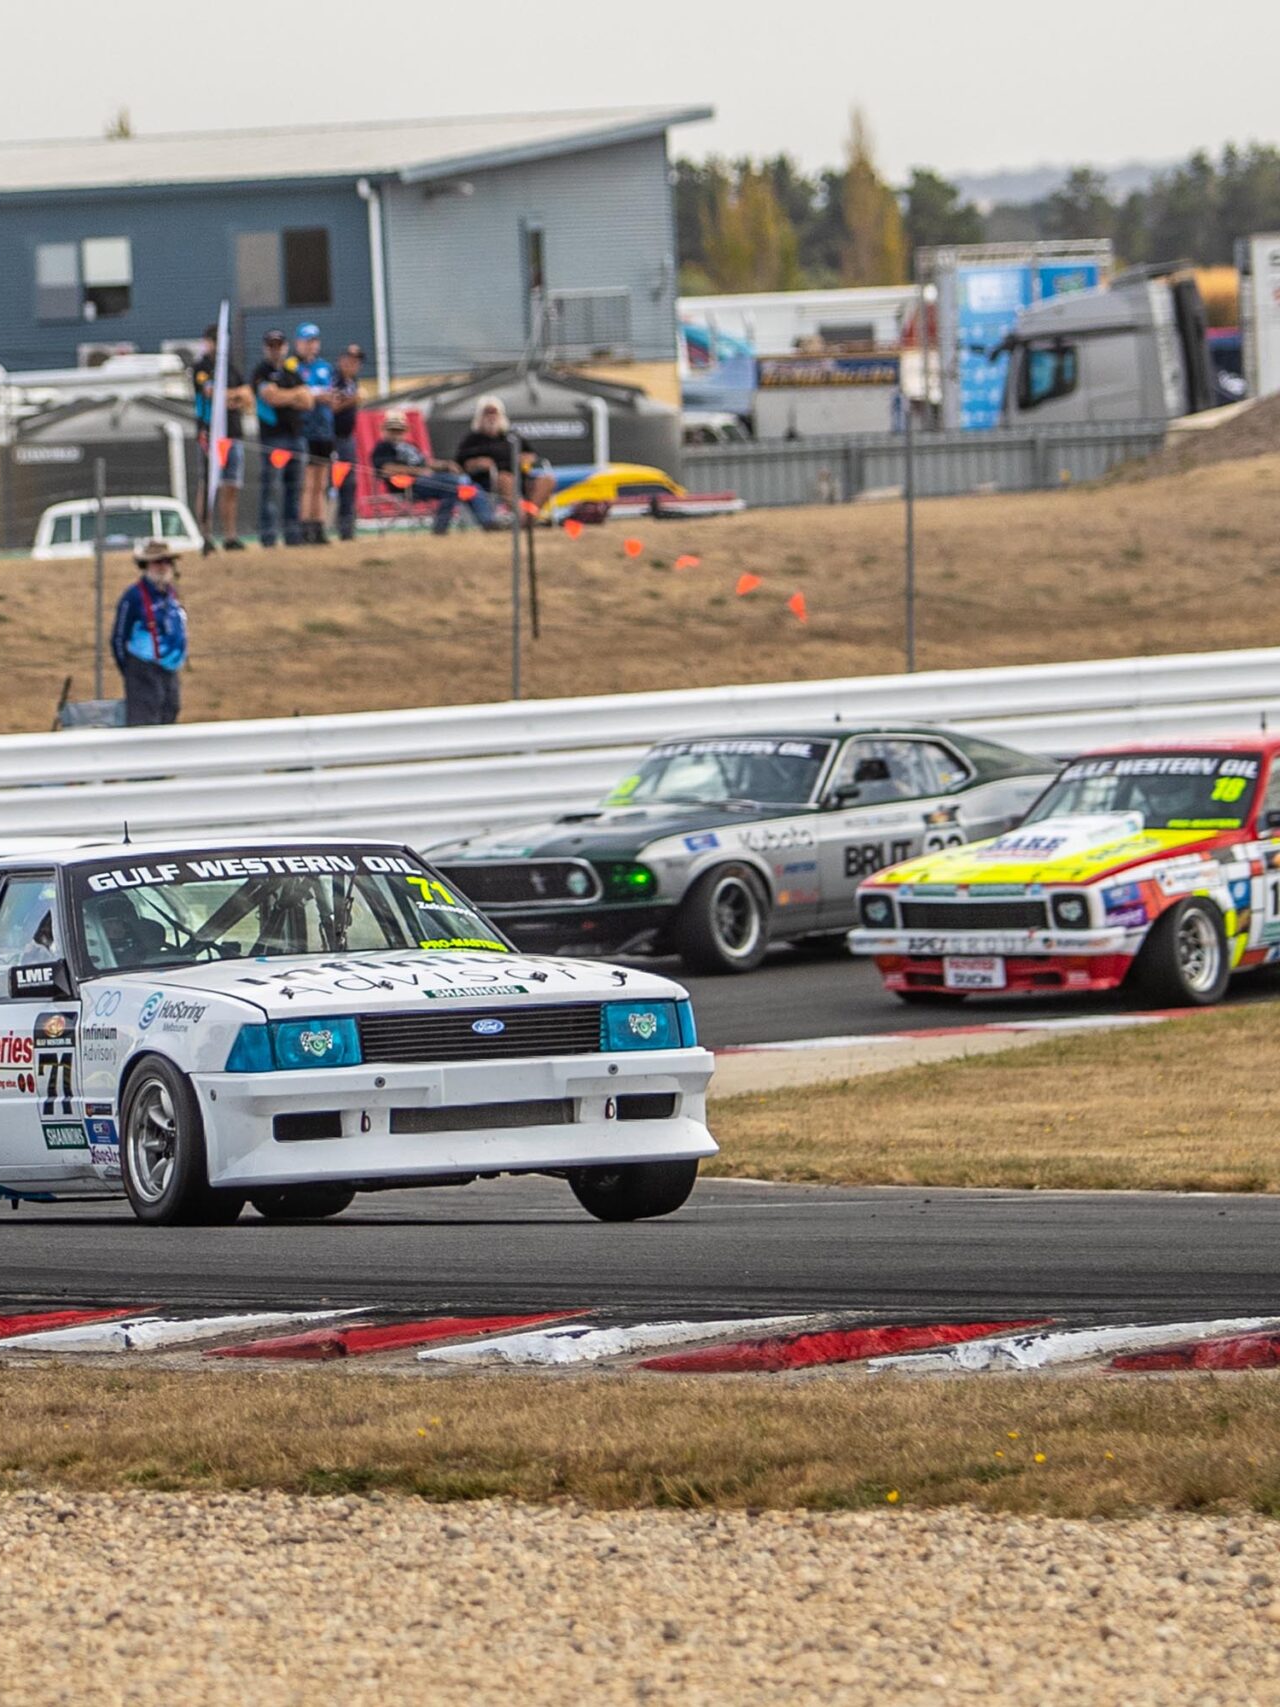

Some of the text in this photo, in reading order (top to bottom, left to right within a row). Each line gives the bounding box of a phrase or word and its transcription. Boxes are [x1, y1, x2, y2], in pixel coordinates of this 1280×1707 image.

[1113, 758, 1219, 776] WESTERN
[1220, 759, 1259, 779] OIL
[737, 825, 814, 852] Kubota
[86, 855, 423, 893] GULF WESTERN OIL
[405, 876, 455, 905] 71
[16, 967, 53, 983] LMF
[430, 985, 520, 998] SHANNONS
[159, 1001, 207, 1023] HotSpring
[83, 1024, 117, 1040] Infinium
[83, 1044, 117, 1065] Advisory
[37, 1052, 73, 1115] 71
[46, 1128, 85, 1146] SHANNONS
